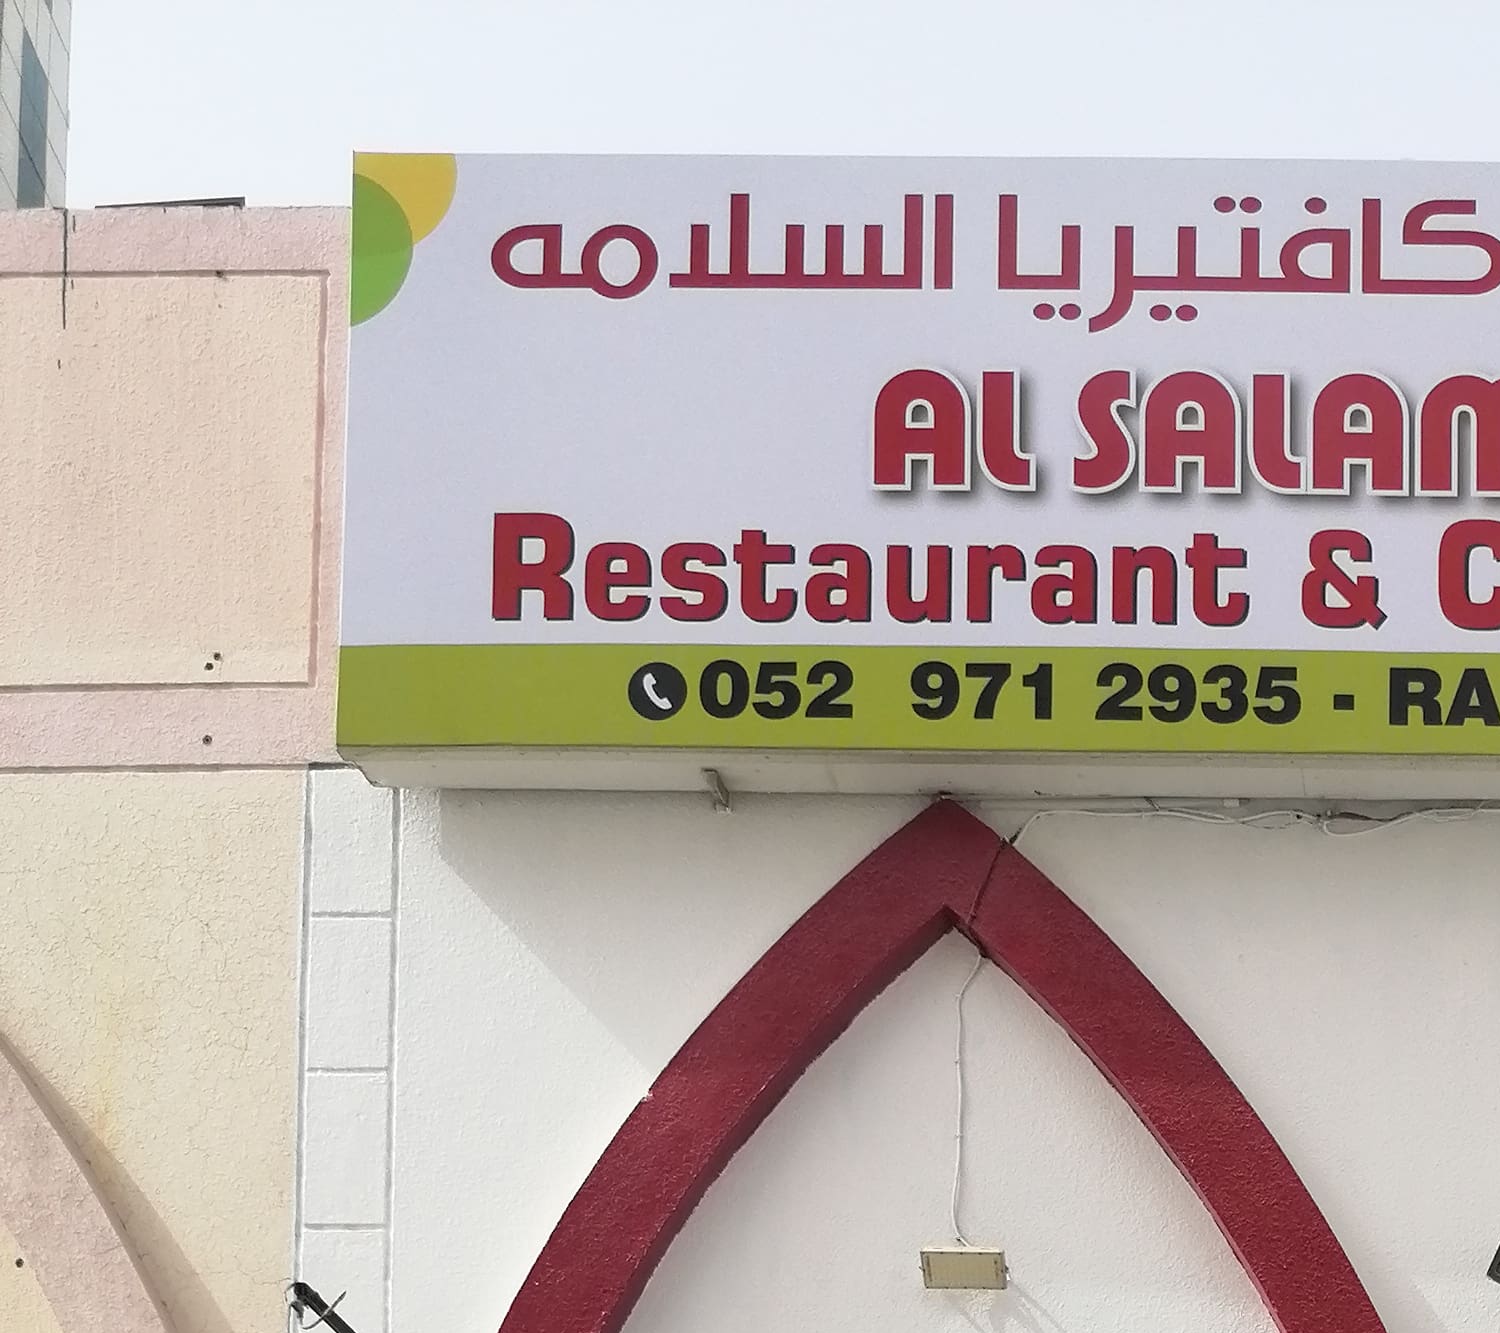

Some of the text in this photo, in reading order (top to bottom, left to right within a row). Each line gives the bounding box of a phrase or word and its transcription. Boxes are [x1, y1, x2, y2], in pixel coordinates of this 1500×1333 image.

[490, 192, 953, 299] السلامه
[872, 367, 1035, 491] AL
[491, 513, 1250, 627] Restaurant
[1301, 529, 1388, 631] &
[699, 659, 854, 720] 052
[910, 660, 1053, 721] 971
[1094, 662, 1302, 725] 2935
